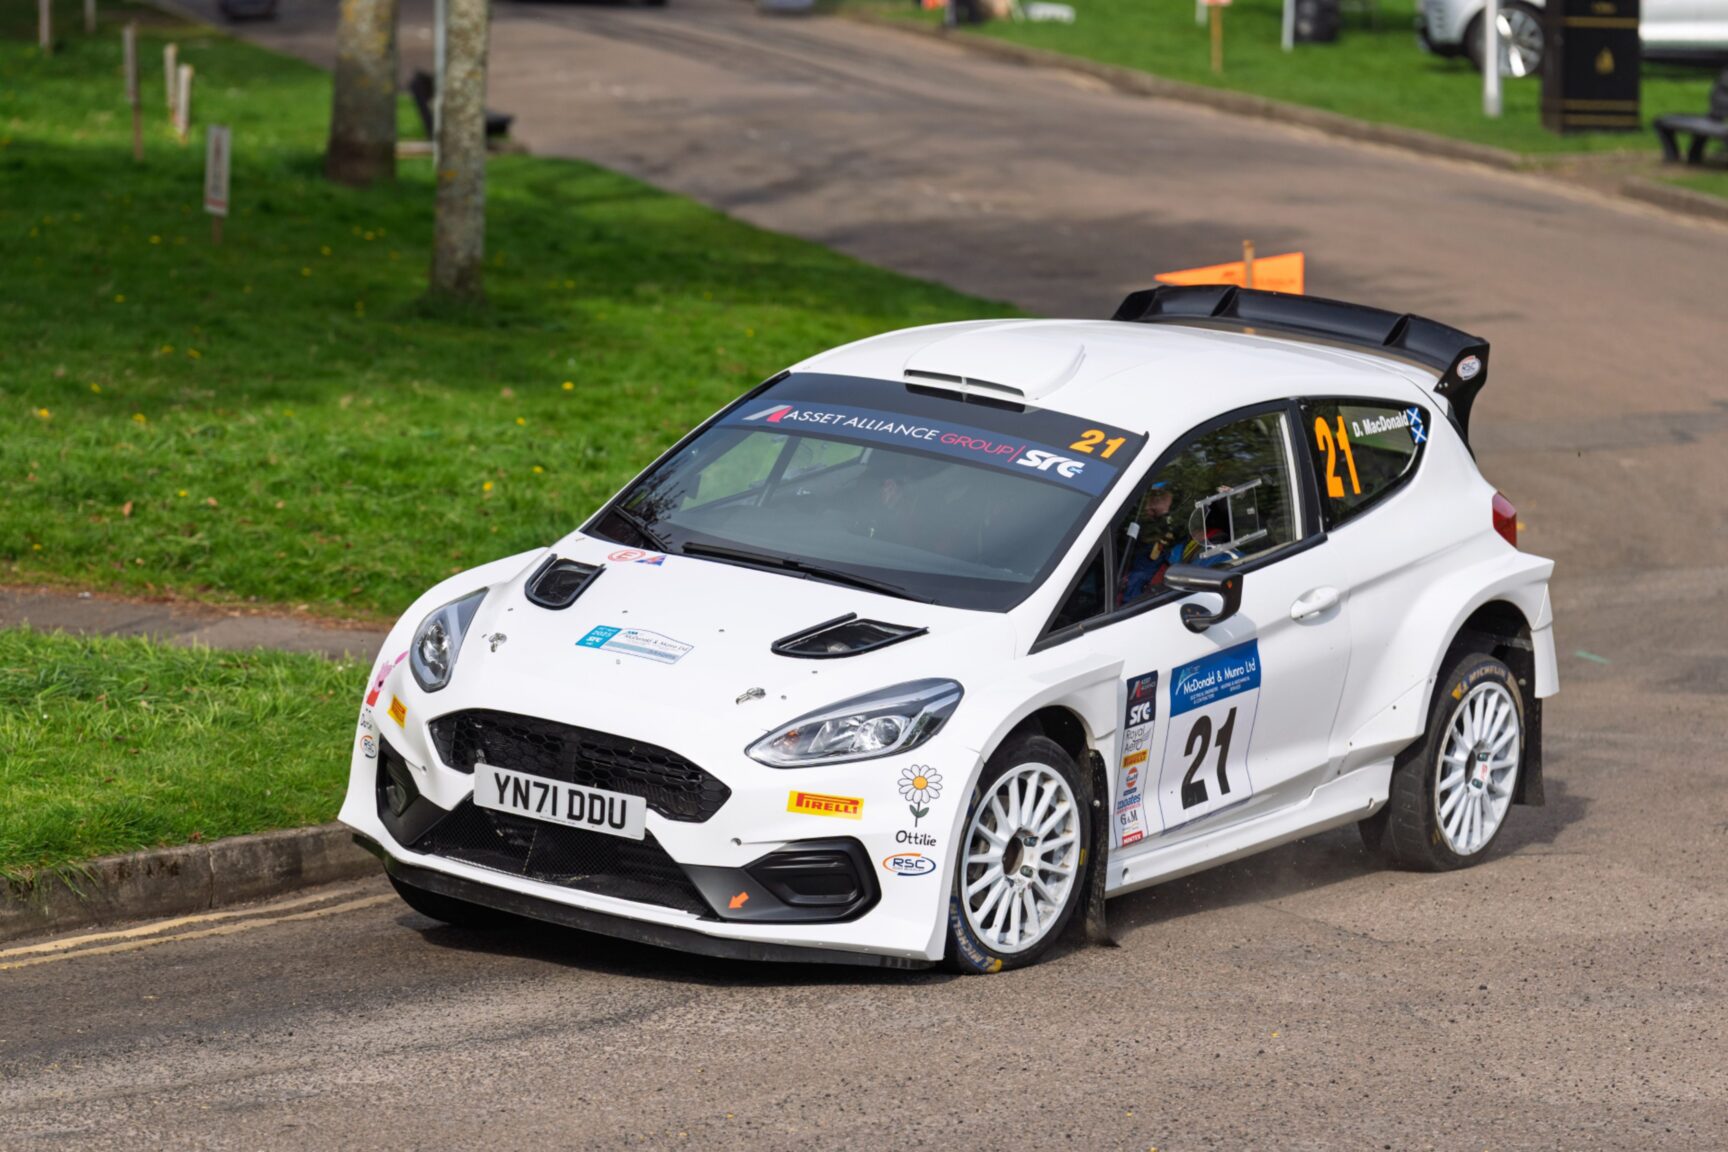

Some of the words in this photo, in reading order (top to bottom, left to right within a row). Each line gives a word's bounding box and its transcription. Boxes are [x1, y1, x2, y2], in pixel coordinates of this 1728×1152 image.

[783, 409, 847, 426] ASSET
[842, 416, 942, 442] ALLIANCE
[940, 432, 1014, 457] GROUP
[1352, 422, 1364, 438] D.
[1363, 411, 1409, 436] MacDonald
[1069, 428, 1128, 459] 21
[1313, 415, 1361, 498] 21
[1183, 671, 1215, 695] McDonald
[1217, 670, 1223, 683] &
[1224, 666, 1244, 681] Munro
[1245, 657, 1256, 673] Ltd
[1181, 707, 1237, 810] 21
[494, 772, 558, 816] YN71
[567, 789, 627, 830] DDU
[795, 792, 860, 815] PIRELLI
[895, 830, 937, 847] Ottilie
[893, 858, 925, 869] RSC
